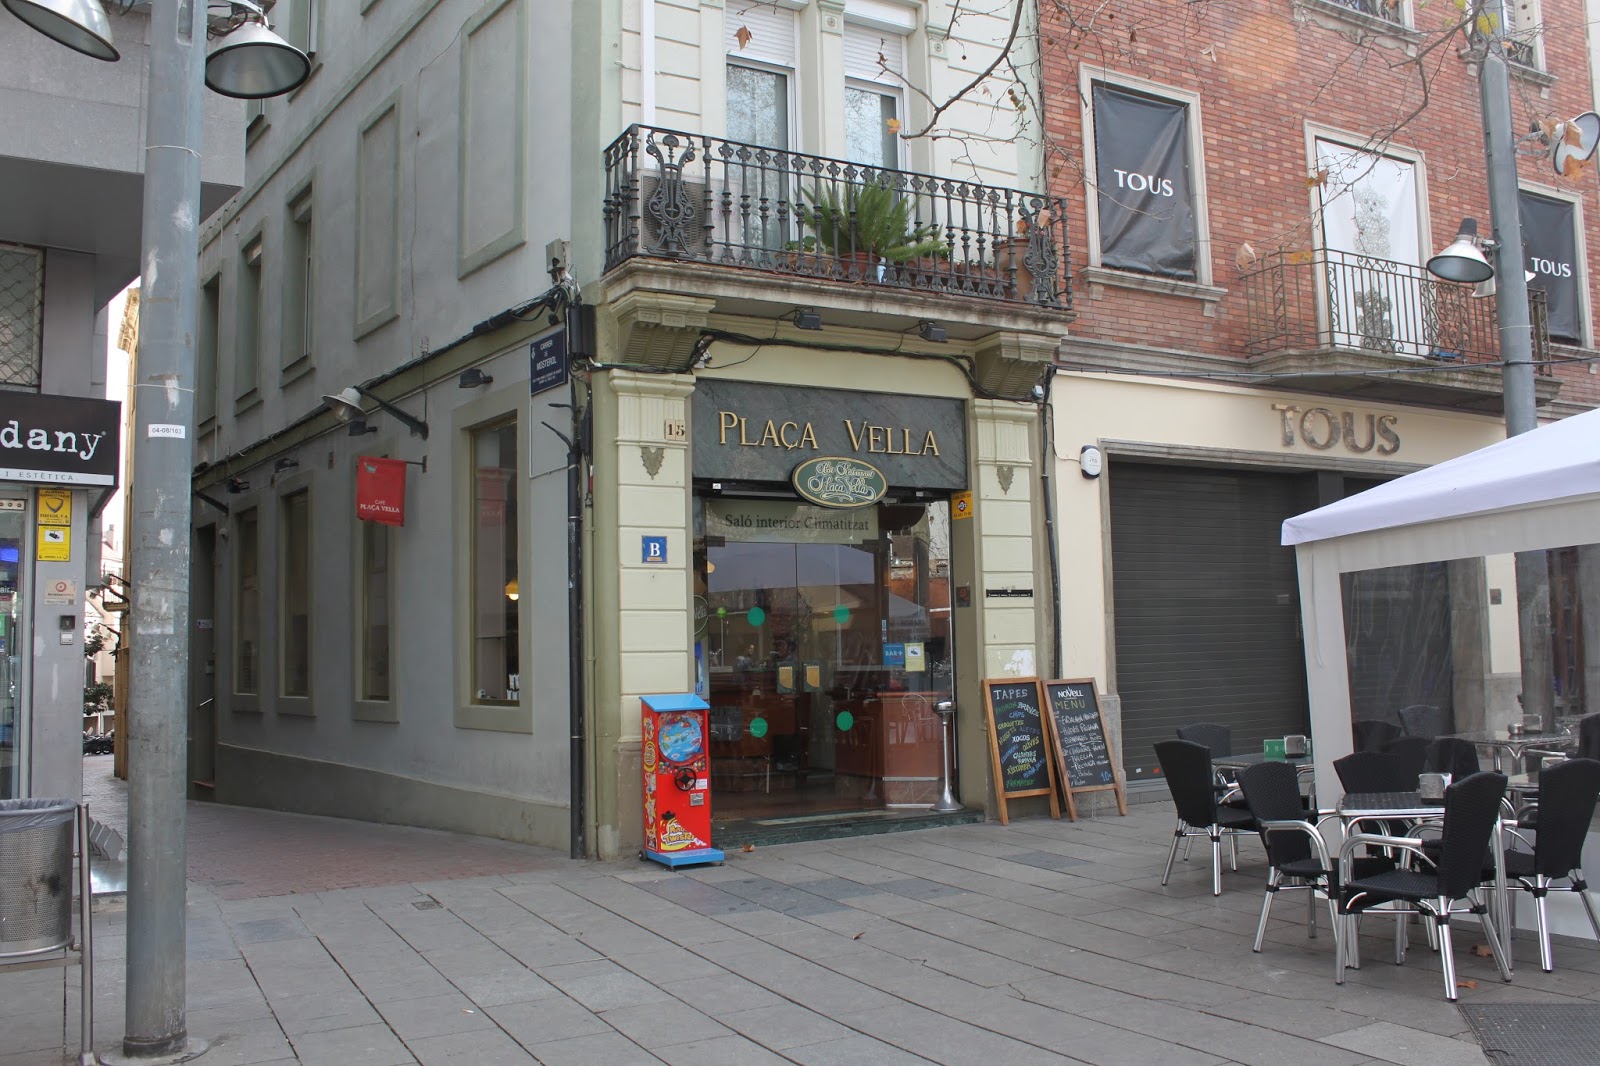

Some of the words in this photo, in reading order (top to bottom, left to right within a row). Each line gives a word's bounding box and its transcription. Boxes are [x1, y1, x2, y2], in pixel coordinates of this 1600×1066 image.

[1114, 169, 1174, 197] TOUS
[1531, 256, 1572, 279] TOUS
[667, 423, 686, 437] 15
[719, 411, 819, 450] PLAÇA
[844, 419, 941, 456] VELLA
[1271, 403, 1401, 455] TOUS
[0, 419, 103, 461] dany
[381, 505, 400, 513] VELLA
[725, 514, 753, 528] Saló
[756, 515, 800, 529] interior
[649, 542, 661, 557] B
[993, 688, 1028, 700] TAPES
[1055, 700, 1086, 710] MENU
